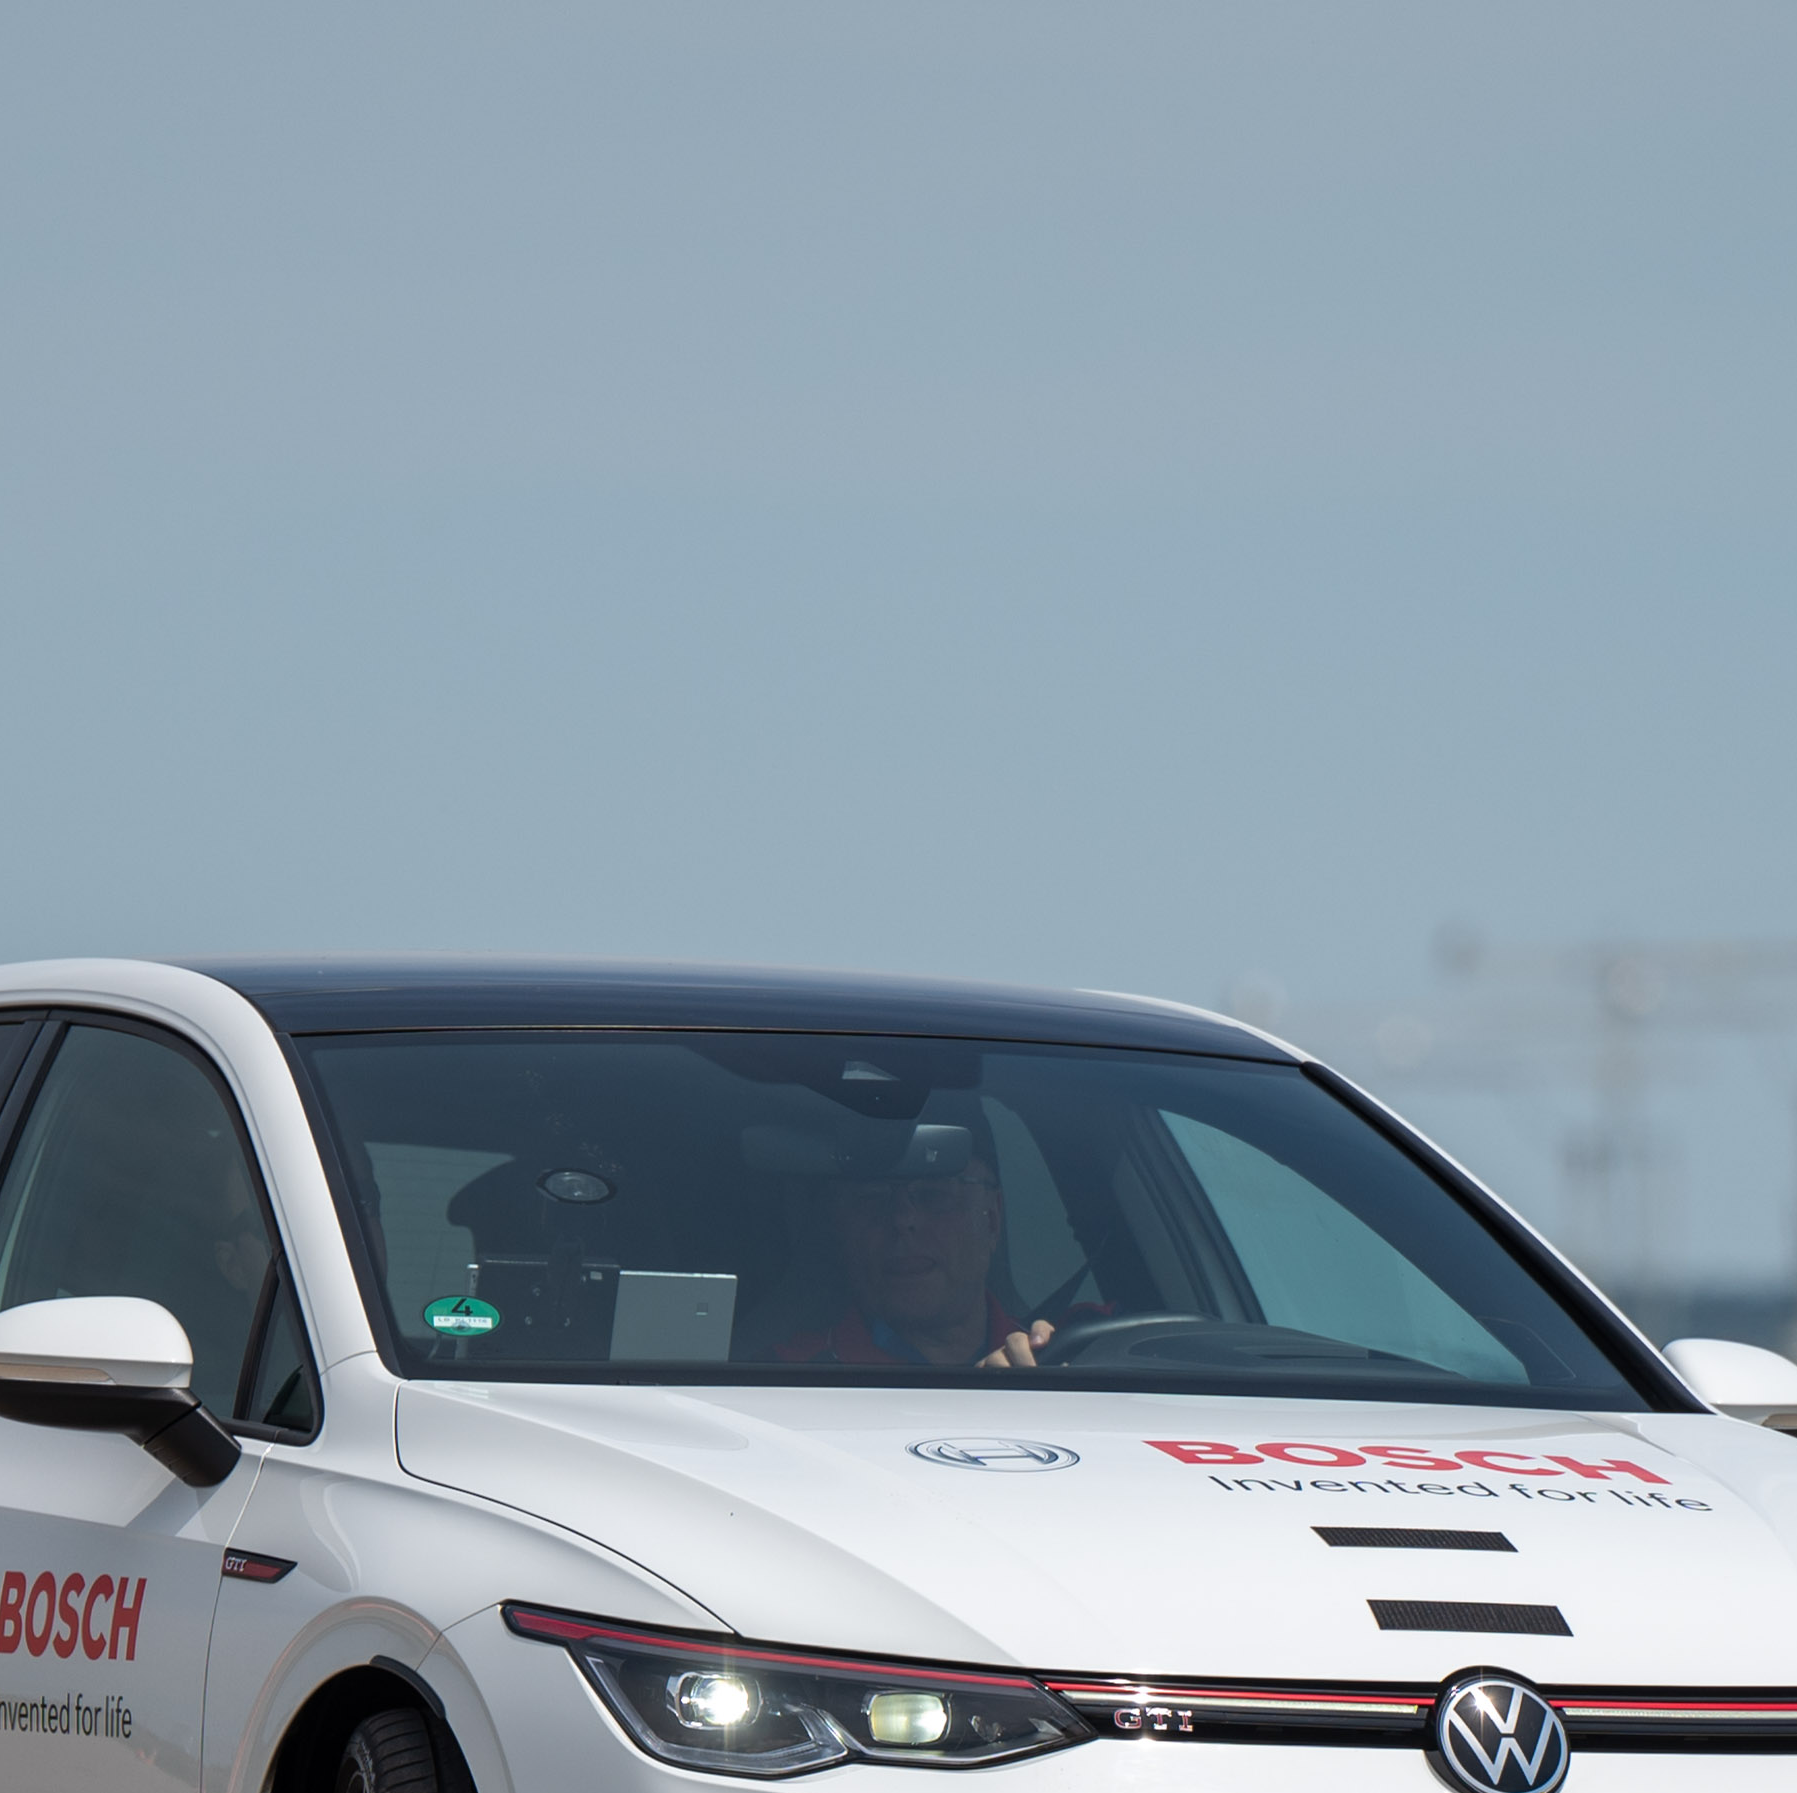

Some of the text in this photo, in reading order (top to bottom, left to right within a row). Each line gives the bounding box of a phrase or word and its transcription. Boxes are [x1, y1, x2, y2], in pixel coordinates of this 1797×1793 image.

[451, 1298, 473, 1315] 4
[1141, 1440, 1673, 1485] BOSCH
[1207, 1475, 1713, 1512] Invented for life
[225, 1557, 247, 1572] GTI
[75, 1693, 102, 1737] for
[105, 1696, 132, 1739] life
[1114, 1707, 1193, 1731] GTI
